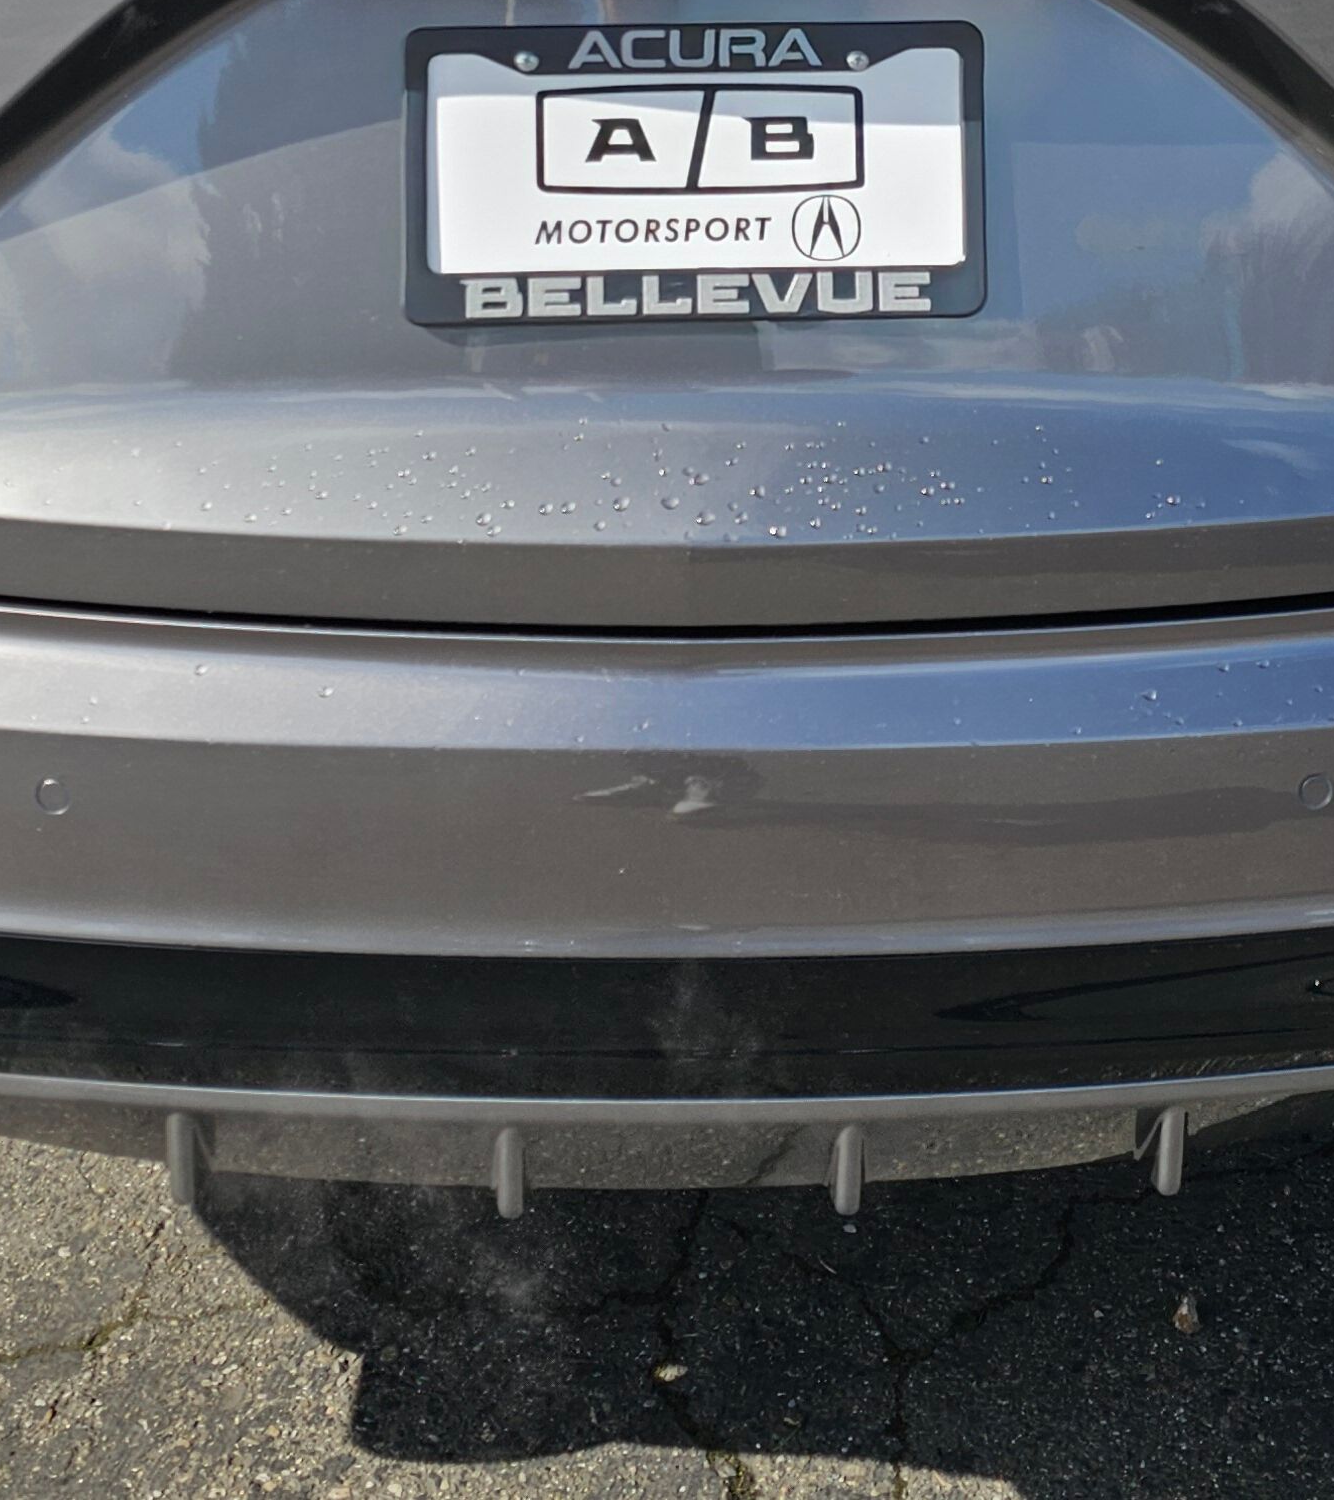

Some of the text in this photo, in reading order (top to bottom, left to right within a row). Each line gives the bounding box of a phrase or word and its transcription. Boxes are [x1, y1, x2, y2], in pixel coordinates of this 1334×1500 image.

[567, 27, 823, 70] ACURA
[534, 216, 772, 245] MOTORSPORT
[459, 271, 932, 319] BELLEVUE
